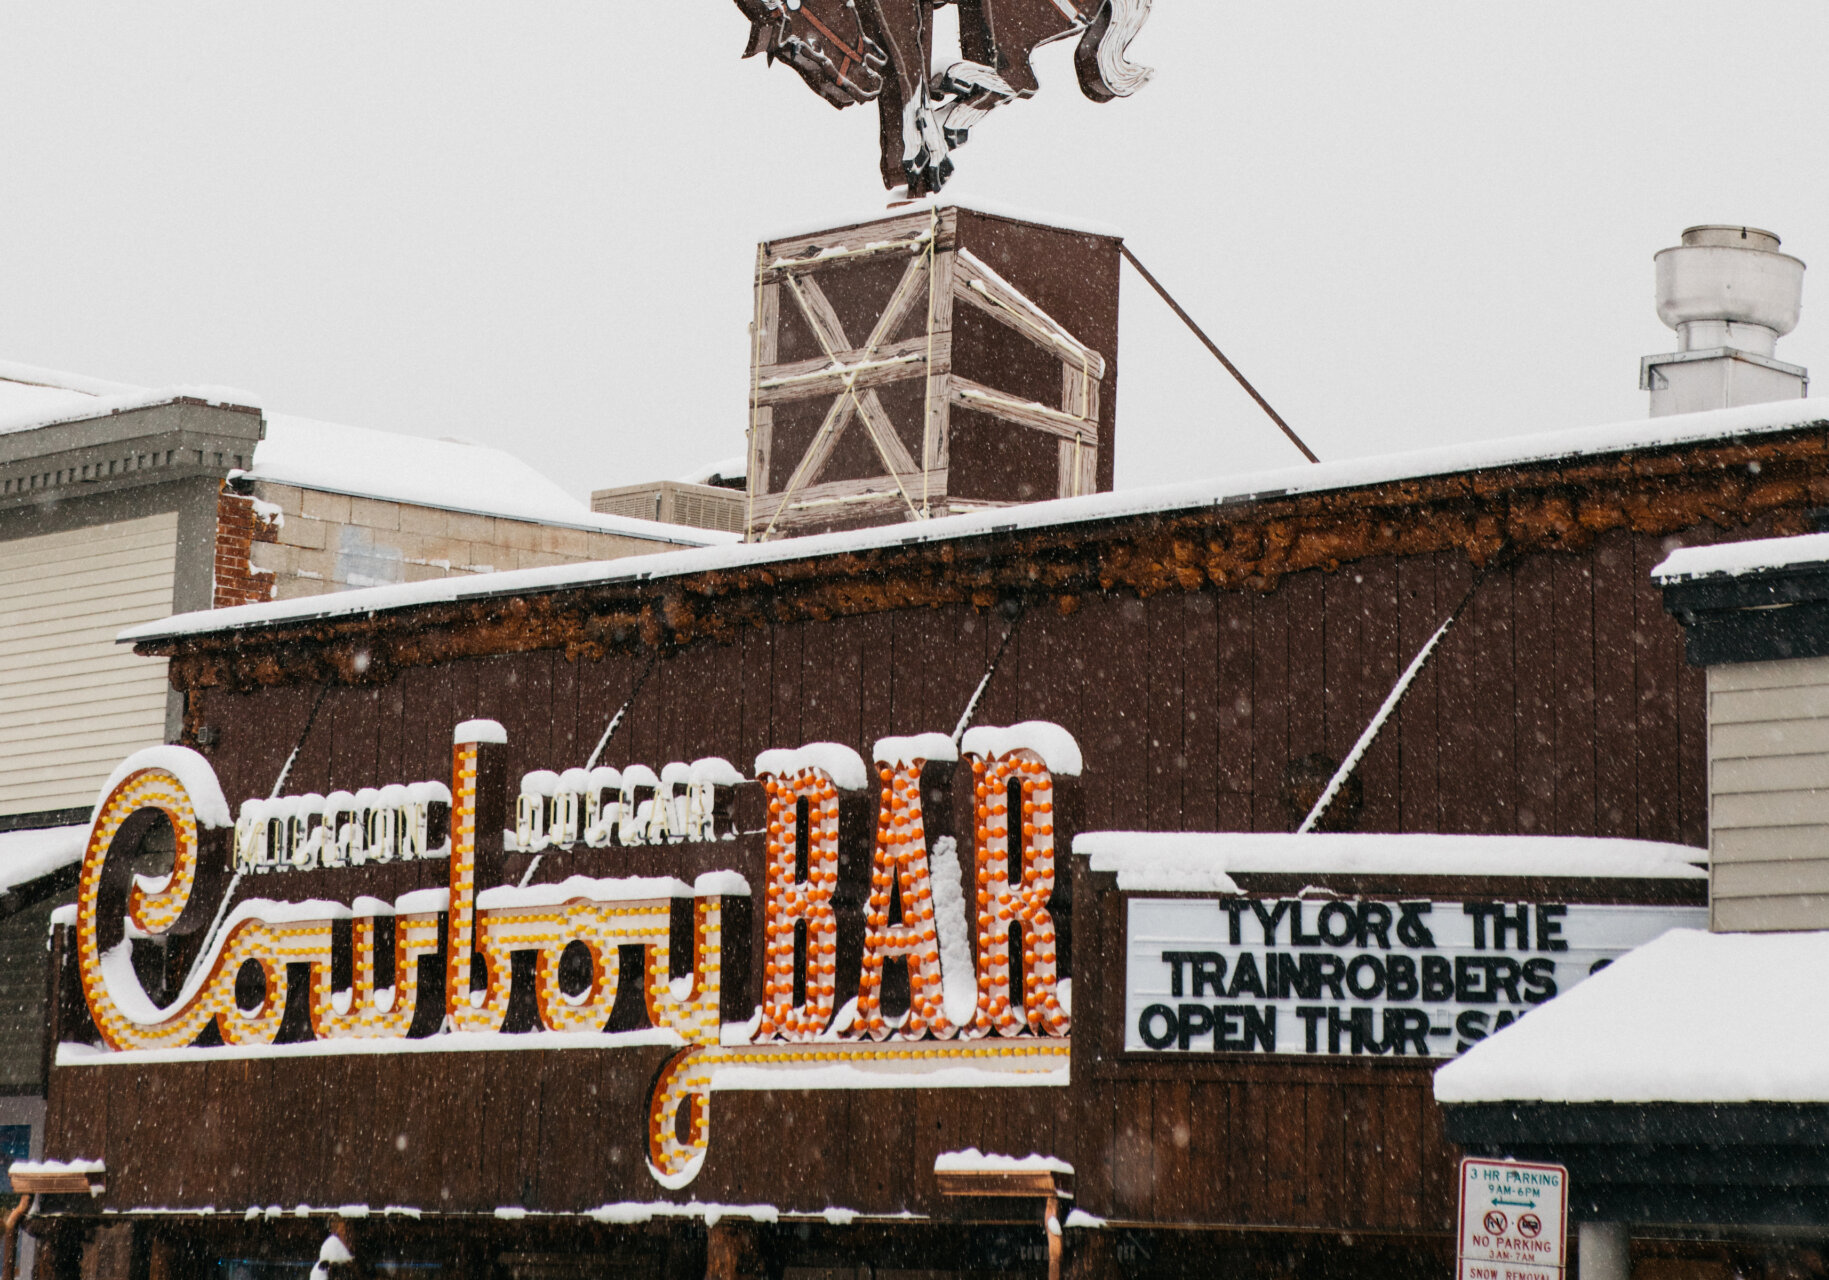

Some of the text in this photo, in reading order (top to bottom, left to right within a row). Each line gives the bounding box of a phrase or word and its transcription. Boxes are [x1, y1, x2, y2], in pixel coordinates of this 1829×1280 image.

[1463, 902, 1569, 952] THE
[76, 741, 1072, 1184] Cowboy BAR
[1160, 950, 1559, 1005] TRAINROBBERS
[1137, 1003, 1277, 1053] OPEN
[1470, 1168, 1559, 1186] 3 HR PARKING
[1472, 1234, 1552, 1254] NO PARKING
[1470, 1267, 1498, 1280] SNOW
